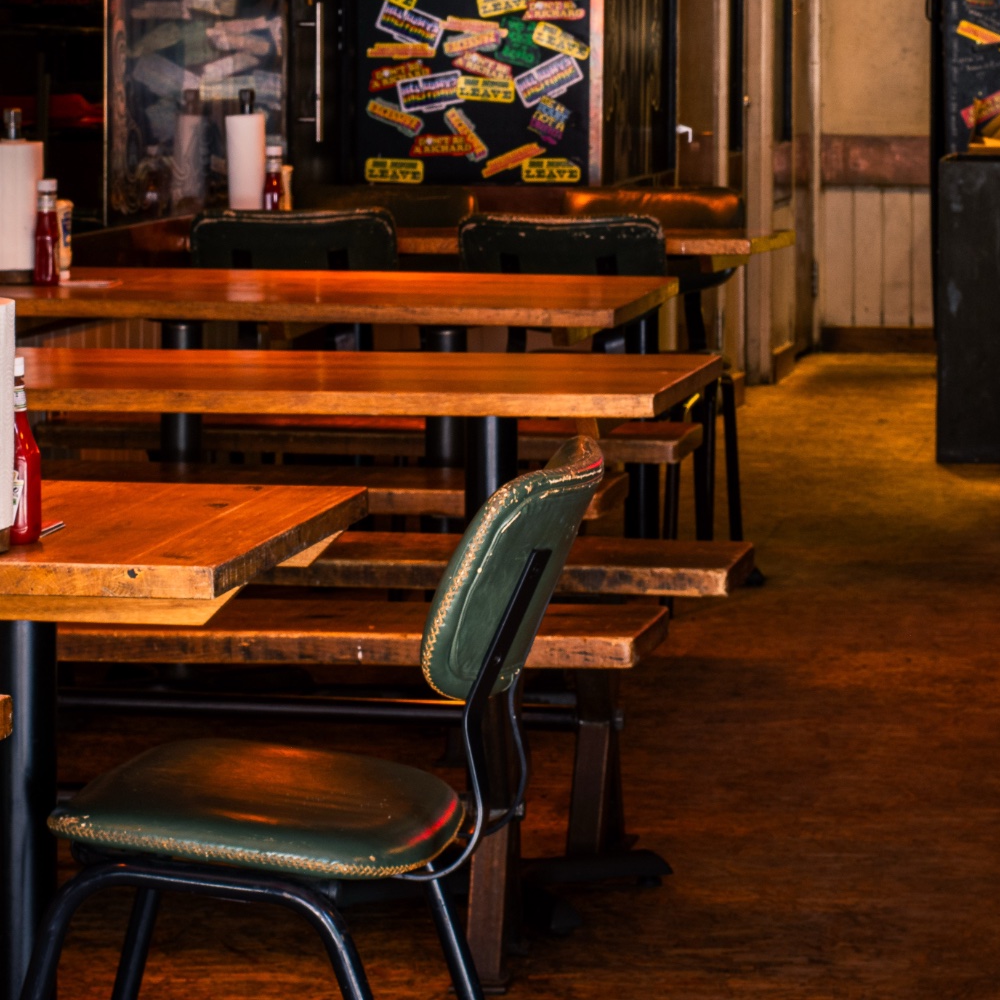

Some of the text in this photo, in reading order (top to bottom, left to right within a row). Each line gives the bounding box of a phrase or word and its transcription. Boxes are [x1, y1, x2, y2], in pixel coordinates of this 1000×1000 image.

[461, 88, 513, 100] LEAVE
[368, 168, 421, 180] LEAVE
[525, 168, 578, 180] LEAVE
